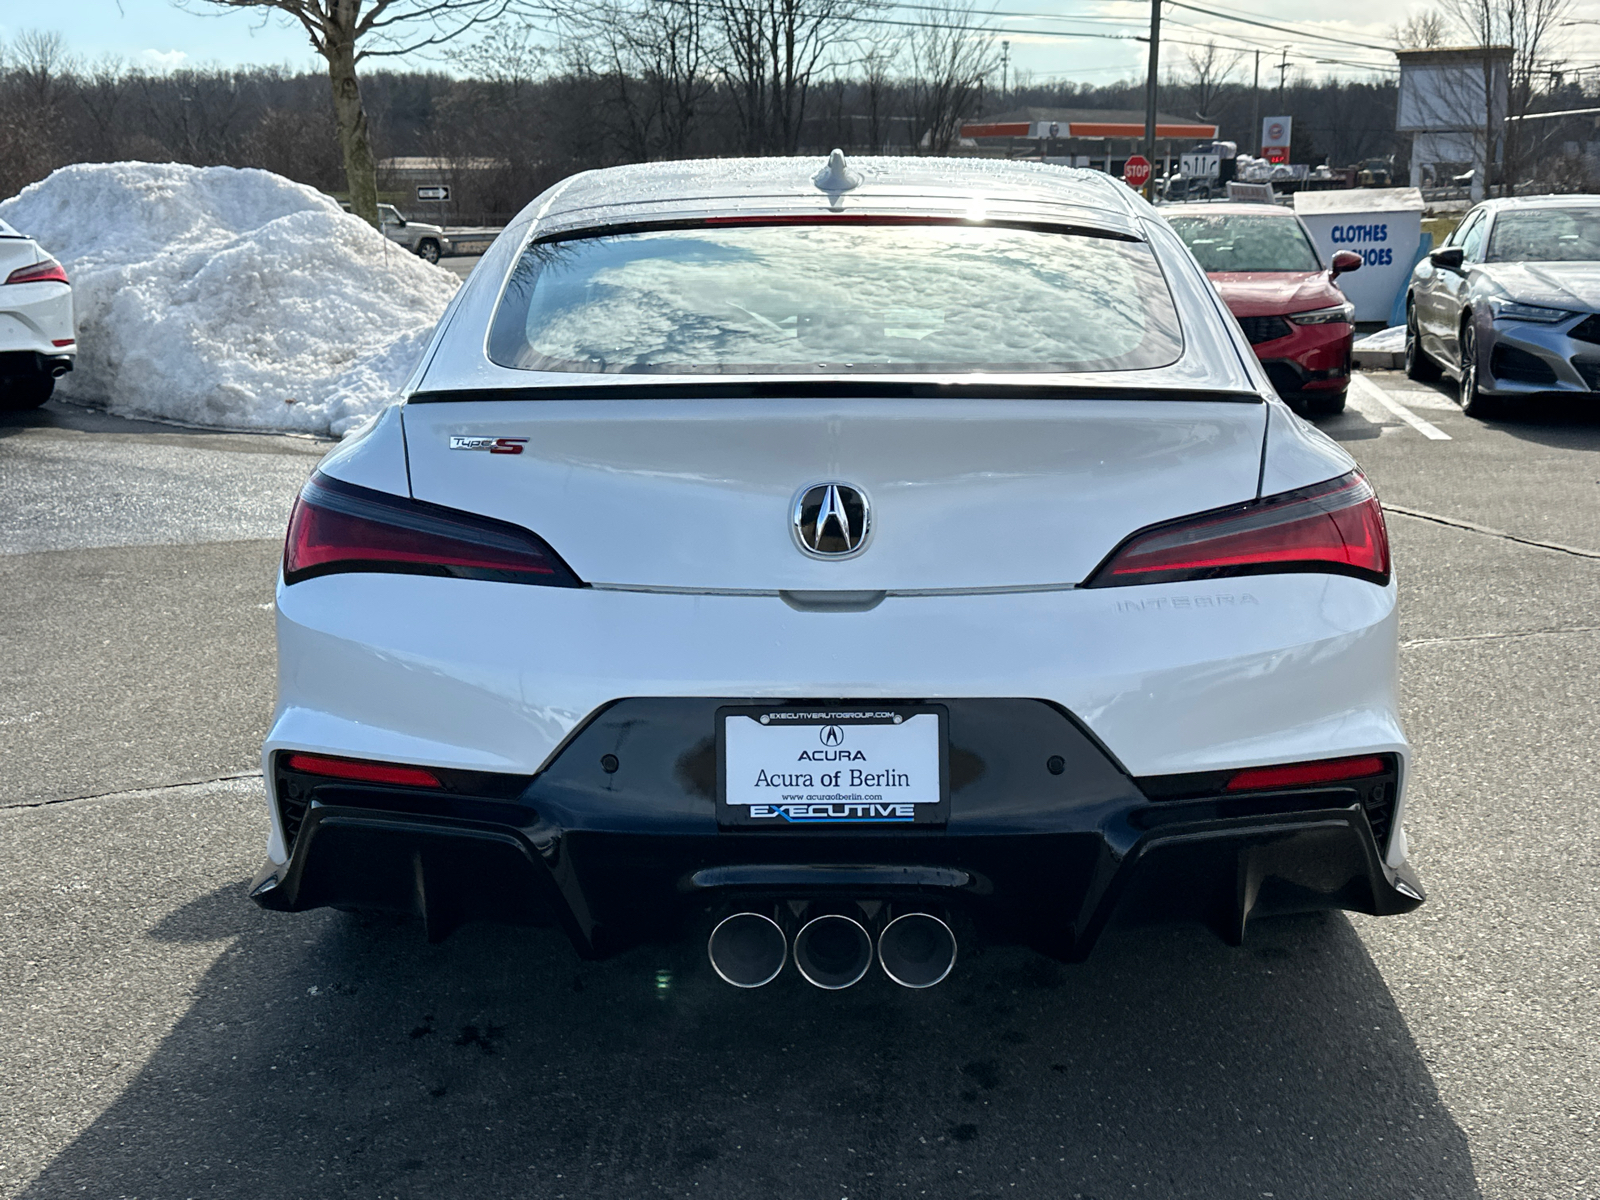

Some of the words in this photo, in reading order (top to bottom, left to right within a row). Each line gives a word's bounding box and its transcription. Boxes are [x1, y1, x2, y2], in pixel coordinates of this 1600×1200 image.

[1126, 165, 1149, 176] STOP
[1331, 224, 1388, 243] CLOTHES
[454, 438, 491, 448] Type
[491, 438, 529, 454] S
[1116, 594, 1260, 611] INTEGRA
[769, 711, 895, 719] EXECUTIVEAUTOGROUP.COM
[797, 750, 867, 761] ACURA
[754, 769, 814, 787] Acura
[820, 771, 842, 787] of
[849, 769, 910, 787] Berlin
[750, 803, 915, 820] EXECUTIVE
